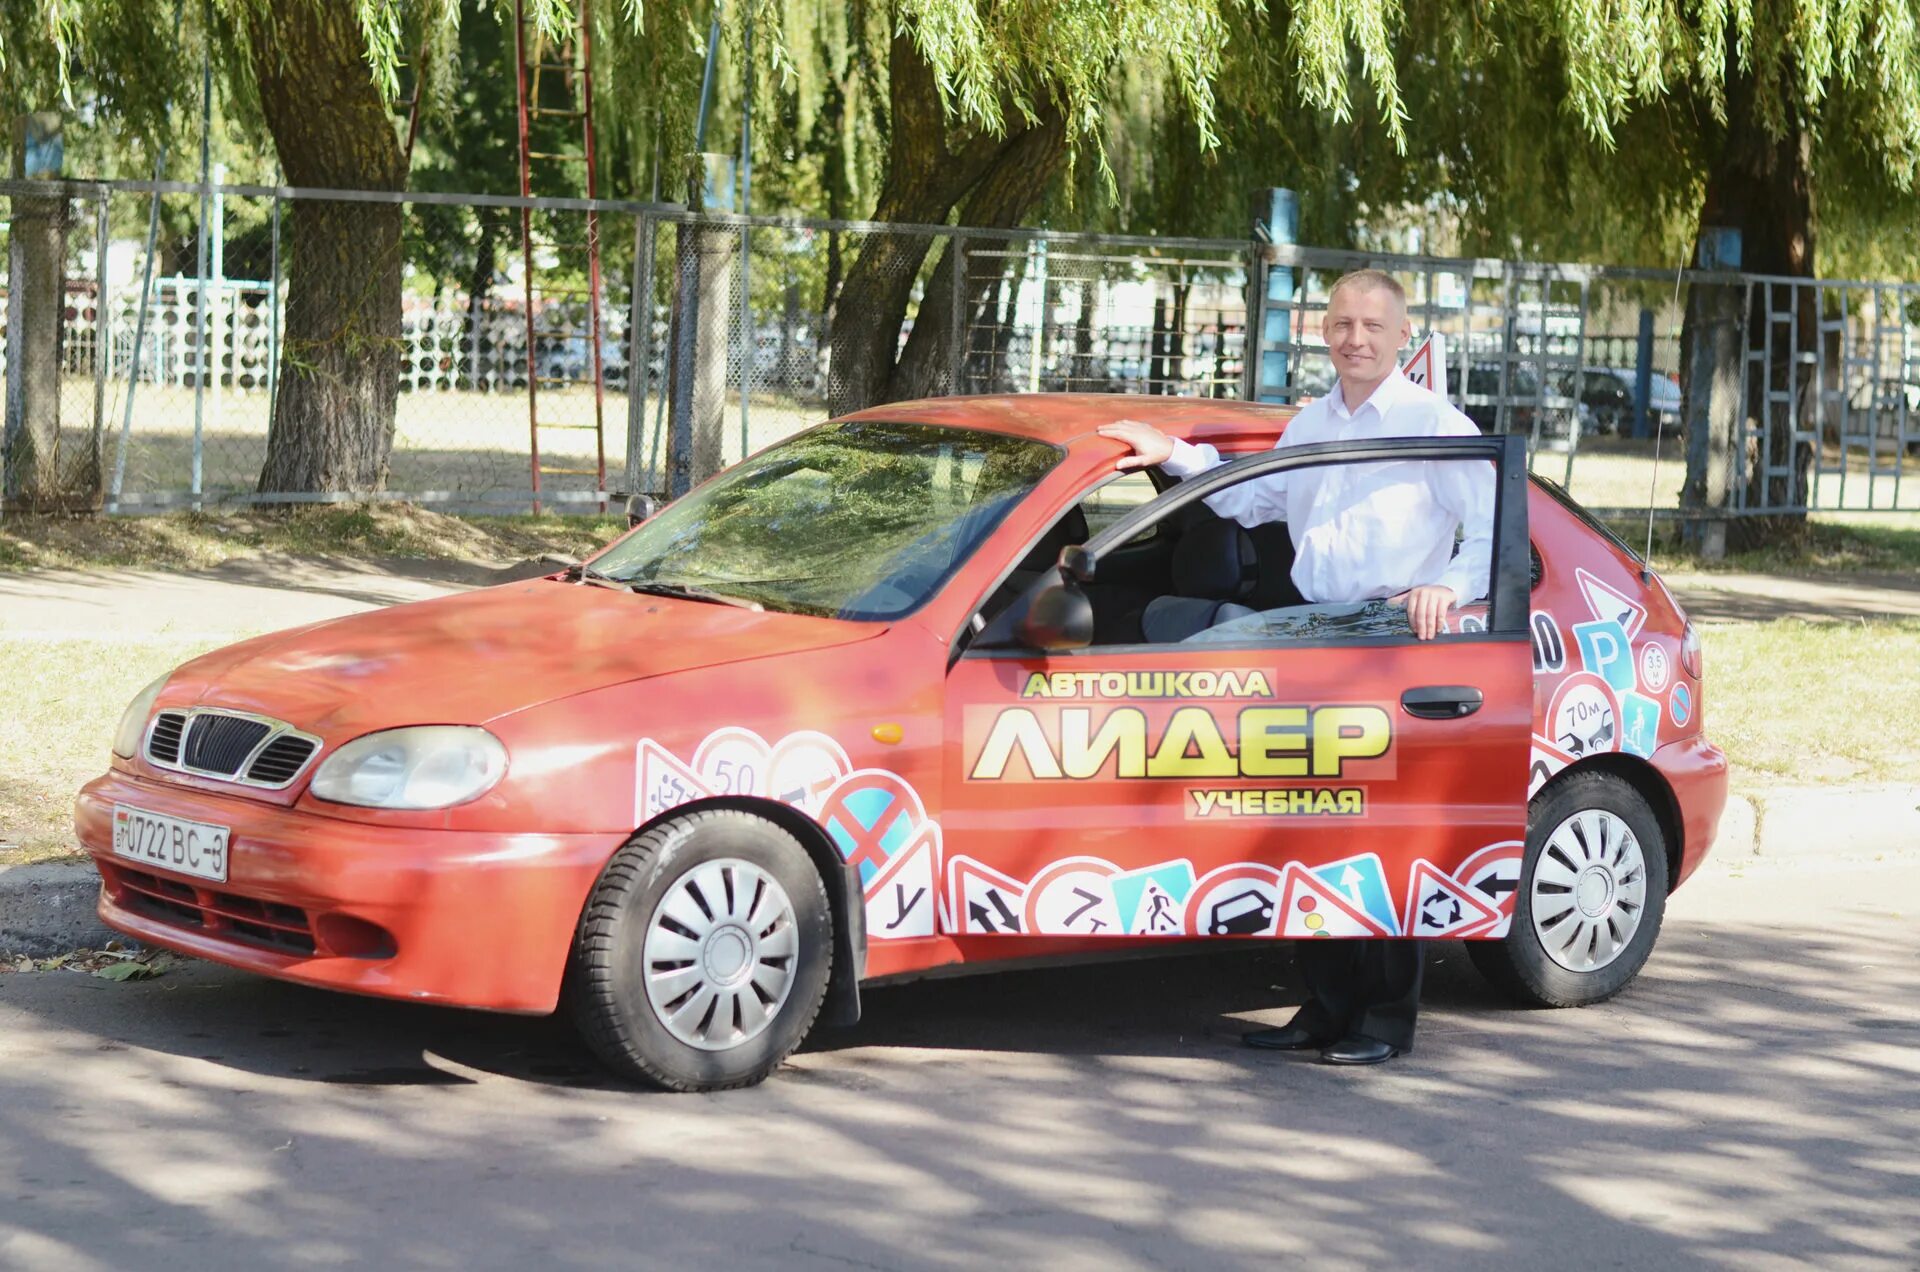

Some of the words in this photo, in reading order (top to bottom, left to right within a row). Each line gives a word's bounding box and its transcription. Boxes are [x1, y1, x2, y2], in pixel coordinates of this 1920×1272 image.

[1588, 631, 1619, 678] P
[1022, 670, 1275, 698] АВТОШКОЛА
[969, 706, 1391, 780] ЛИДЕР
[714, 760, 755, 796] 50
[1189, 788, 1363, 816] УЧЕБНАЯ
[128, 815, 167, 860] 0722
